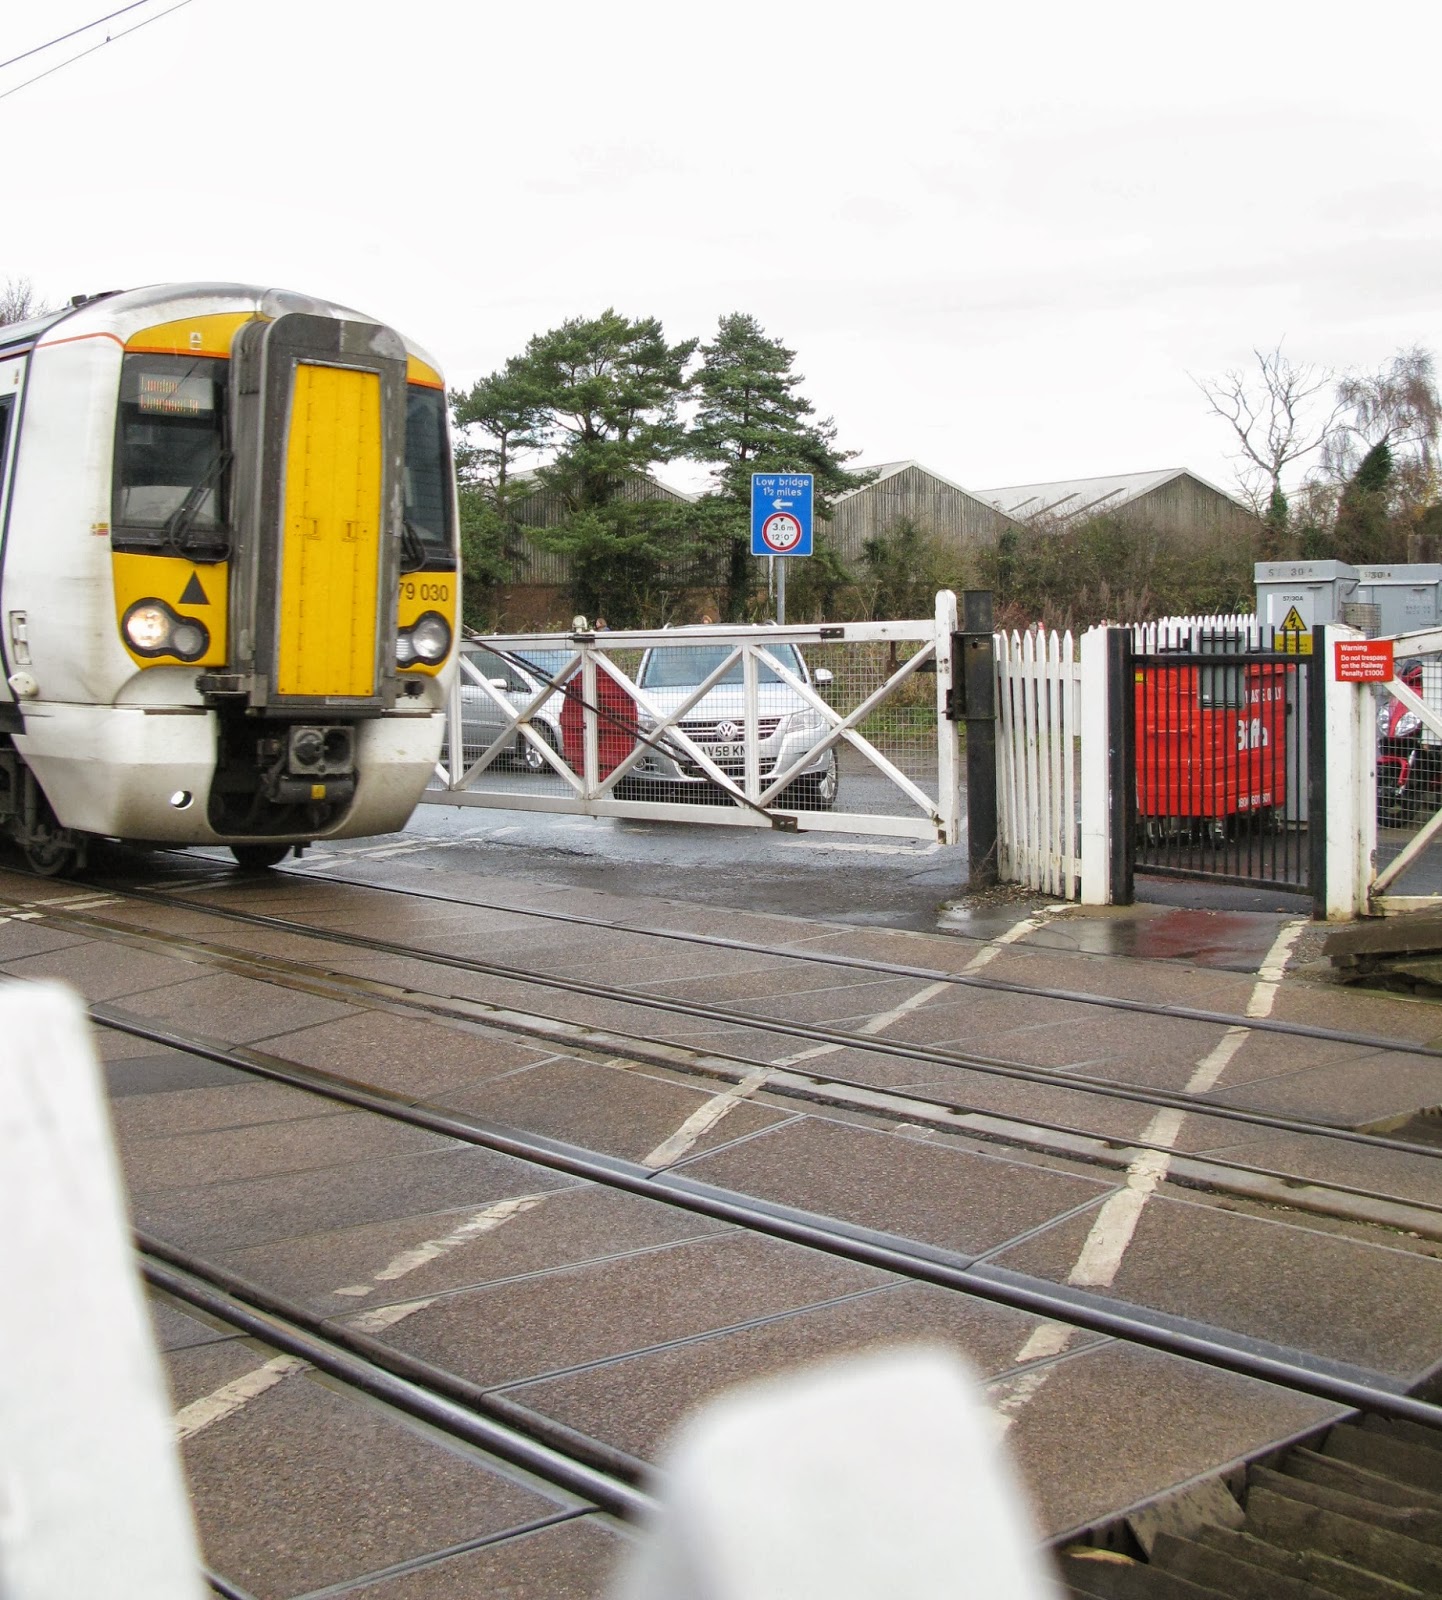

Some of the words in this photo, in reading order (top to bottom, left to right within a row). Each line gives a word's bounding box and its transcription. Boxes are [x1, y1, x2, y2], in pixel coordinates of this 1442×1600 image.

[756, 477, 775, 486] Low
[779, 477, 809, 487] bridge
[776, 487, 802, 496] miles
[421, 584, 449, 601] 030
[1341, 644, 1368, 652] Warning
